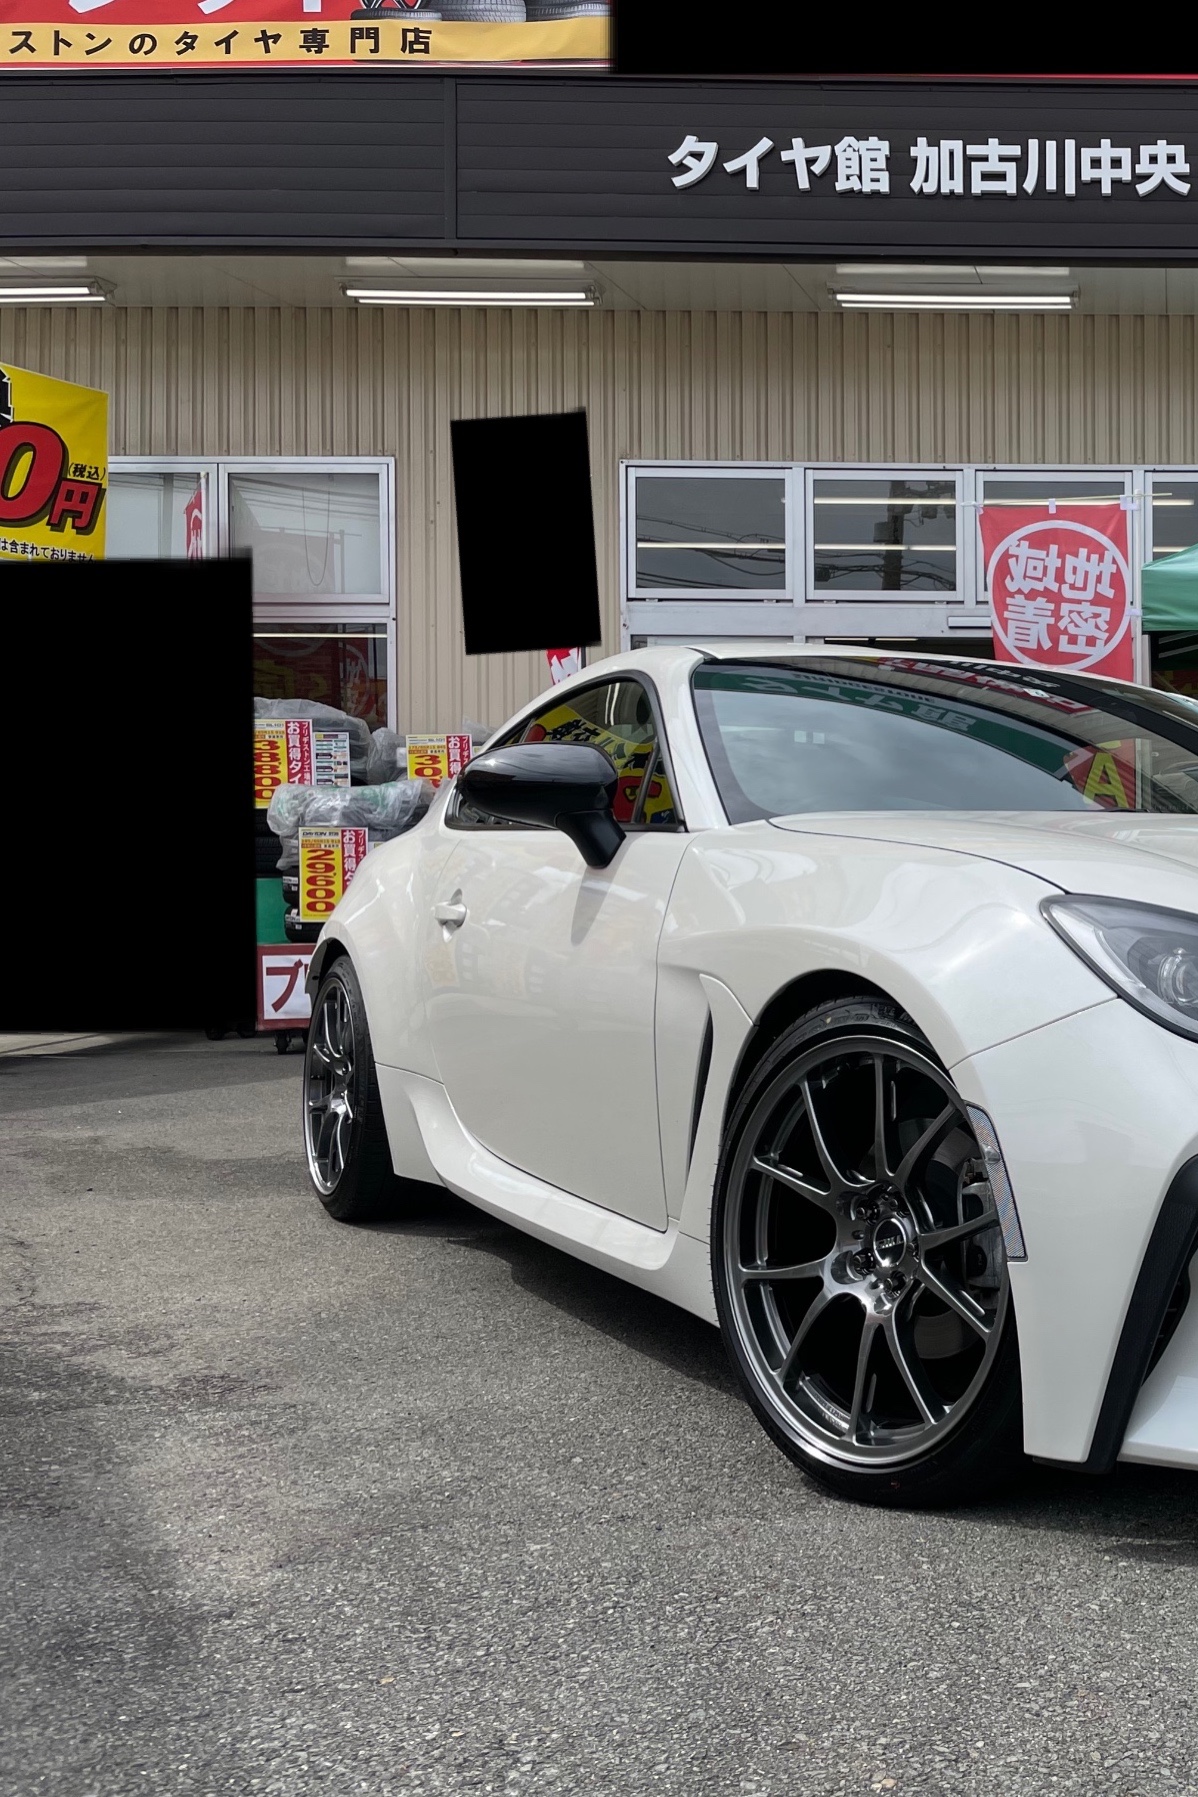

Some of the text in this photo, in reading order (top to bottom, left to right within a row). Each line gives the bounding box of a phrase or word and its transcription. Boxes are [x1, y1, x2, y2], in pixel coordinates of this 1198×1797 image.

[667, 135, 1191, 196] タイヤ館 加古川中央
[68, 462, 107, 481] (税込)
[306, 848, 336, 912] 29,600
